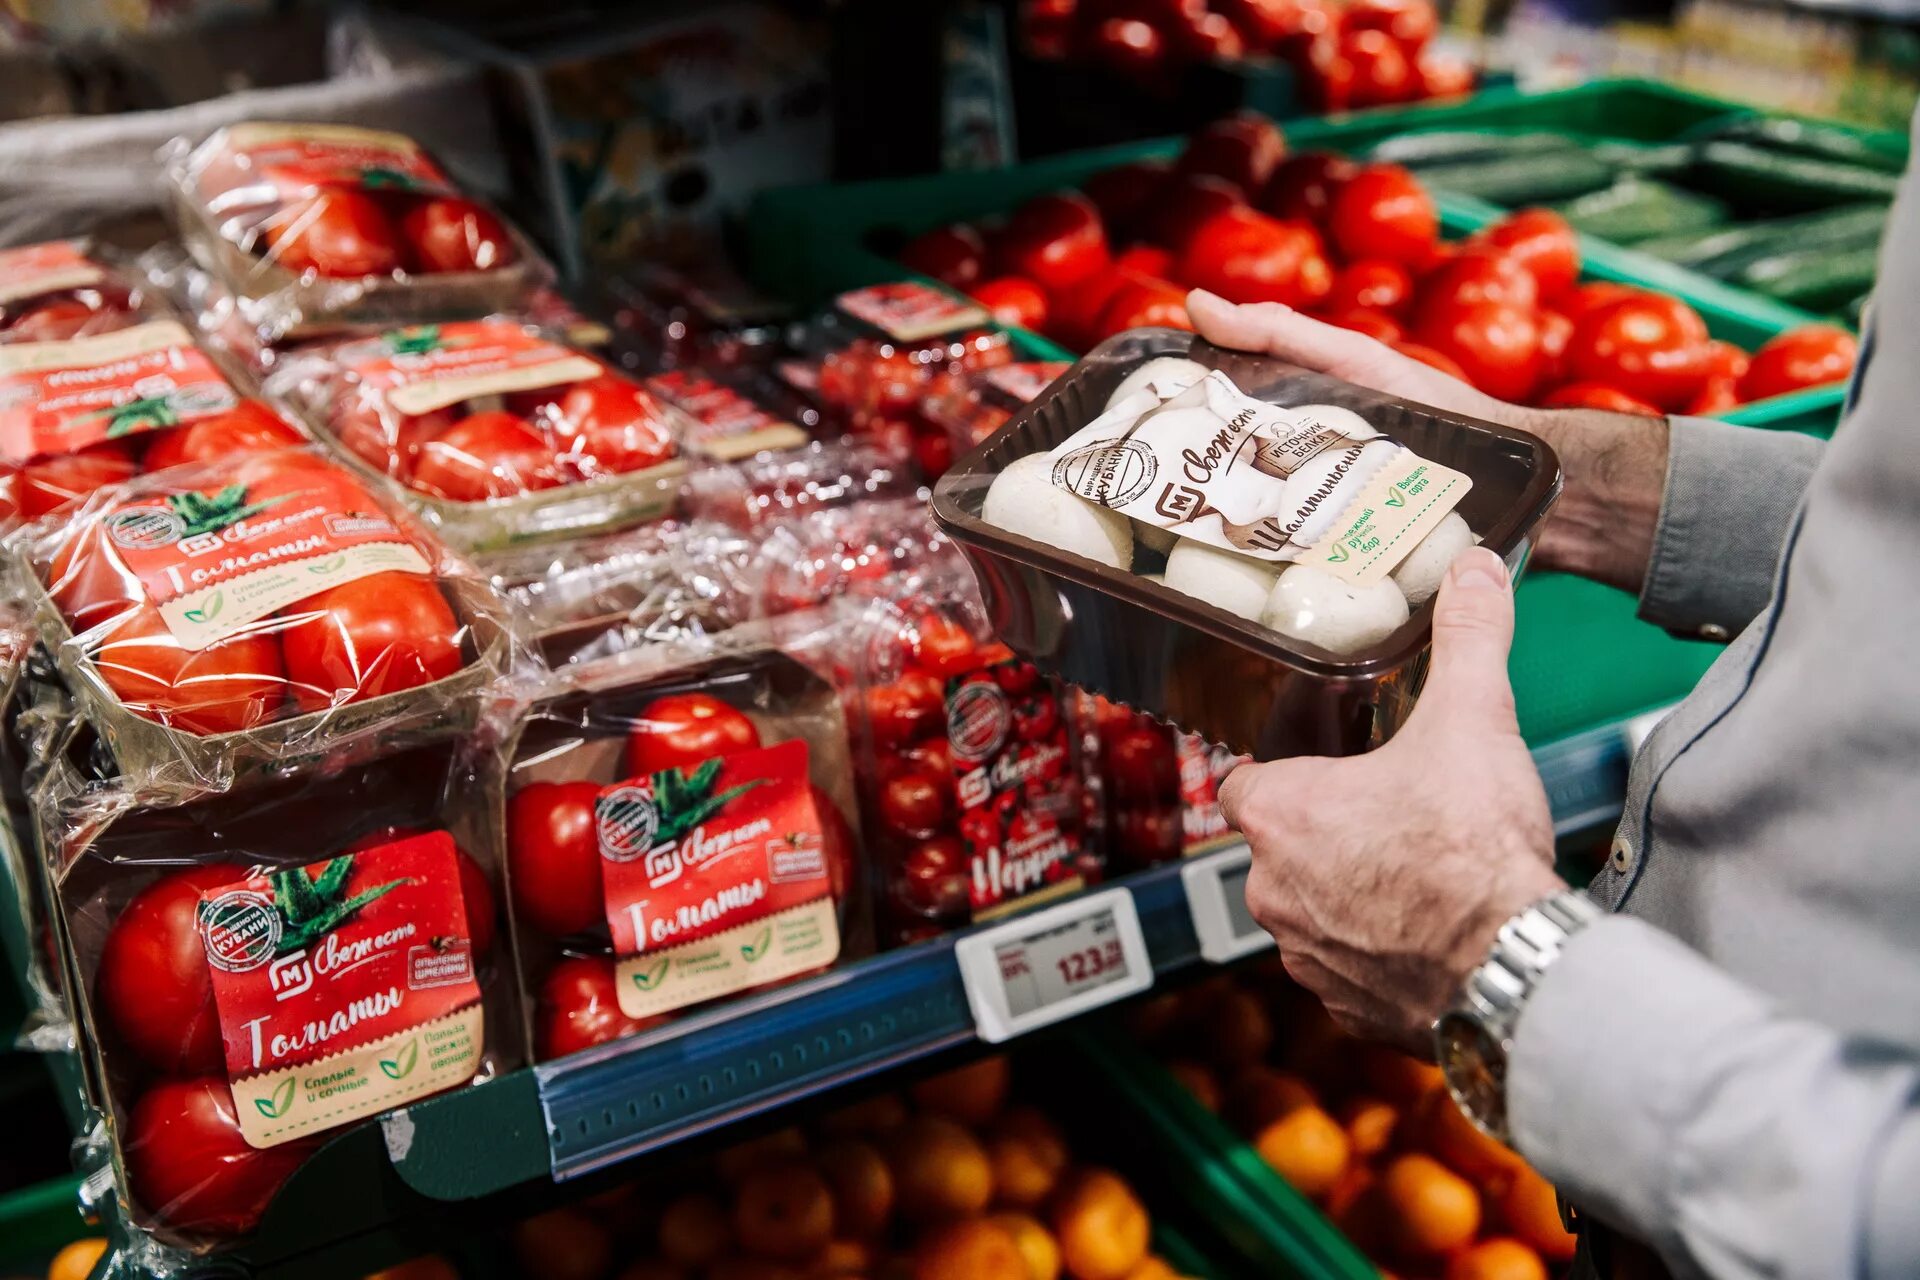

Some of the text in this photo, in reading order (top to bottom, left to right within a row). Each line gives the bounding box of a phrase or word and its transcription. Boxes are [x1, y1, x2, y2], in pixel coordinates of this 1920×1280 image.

[1182, 407, 1257, 484] Свежесть
[1270, 422, 1327, 459] ИСТОЧНИК
[1292, 434, 1329, 458] БЕЛКА
[1084, 449, 1110, 497] ВЫРАЩЕНО НА
[1095, 449, 1126, 498] КУБАНИ
[1396, 465, 1428, 490] Высшего
[1408, 478, 1430, 496] сорта
[1247, 442, 1366, 552] Шампиньоны
[1360, 536, 1380, 554] сбор
[164, 535, 329, 594] Томаты
[212, 910, 262, 943] ВЫРАЩЕНО НА
[623, 878, 768, 951] Томаты
[216, 916, 269, 953] КУБАНИ
[314, 922, 417, 975] Свежесть
[240, 986, 405, 1068] Томаты
[304, 1066, 356, 1090] Спелые
[307, 1077, 369, 1103] и сочные
